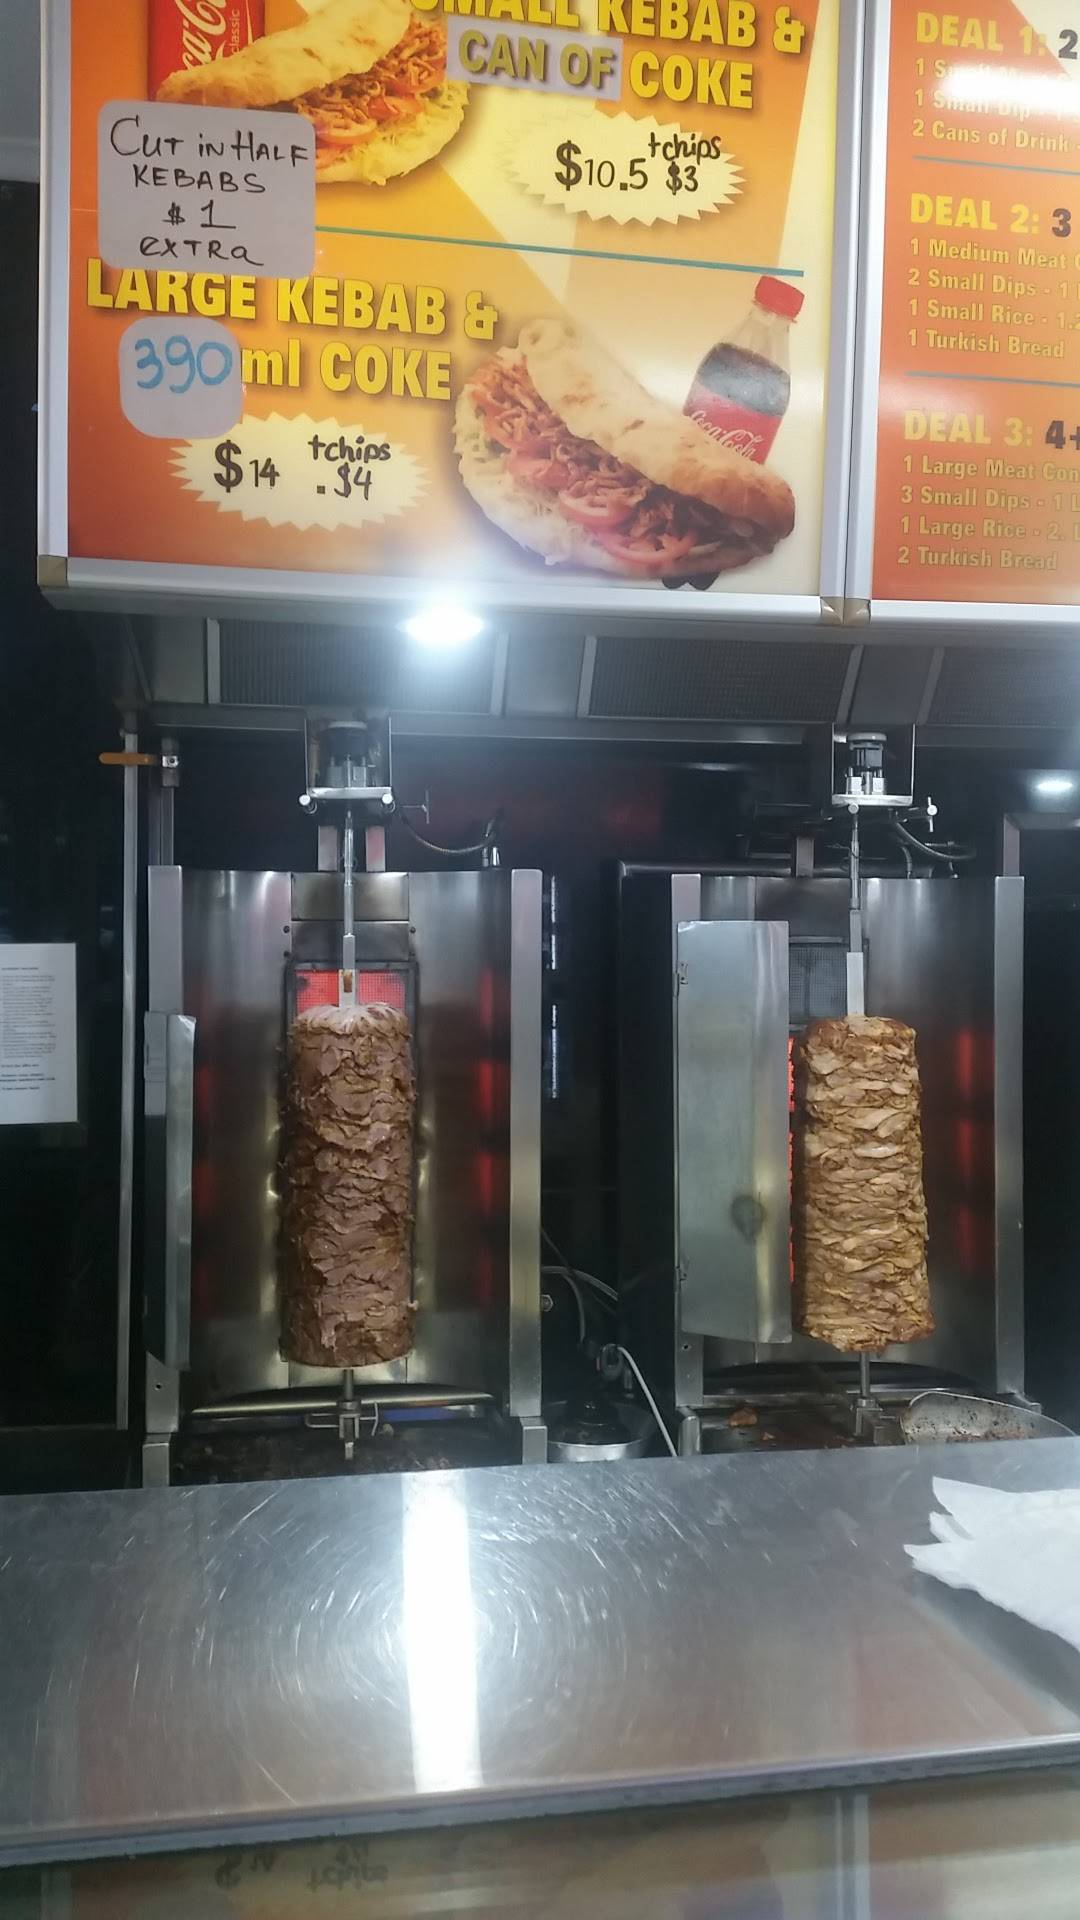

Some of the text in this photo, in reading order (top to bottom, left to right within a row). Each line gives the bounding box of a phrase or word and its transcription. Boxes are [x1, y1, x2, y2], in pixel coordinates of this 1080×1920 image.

[598, 0, 757, 49] KEBAB
[773, 5, 807, 55] &
[916, 11, 1079, 60] DEAL 1: 2
[457, 28, 754, 110] CAN OF COKE
[914, 88, 924, 107] 1
[231, 129, 310, 165] HALF
[912, 119, 1069, 153] 2 Cans of Drink
[132, 163, 266, 194] KEBABS
[666, 161, 700, 196] $3
[910, 192, 1072, 238] DEAL 2: 3
[910, 238, 919, 256] 1
[928, 239, 1009, 265] Medium
[1017, 248, 1067, 270] Meat
[87, 257, 499, 341] LARGE KEBAB &
[908, 268, 920, 286] 2
[928, 269, 984, 291] Small
[992, 275, 1036, 299] Dips
[909, 299, 918, 316] 1
[927, 299, 984, 321] Small
[991, 304, 1035, 325] Rice
[908, 329, 1065, 359] 1 Turkish Bread
[134, 334, 233, 395] 390
[241, 339, 452, 402] ml COKE
[904, 409, 991, 445] DEAL
[1004, 416, 1032, 448] 3:
[903, 454, 912, 473] 1
[922, 455, 978, 479] Large
[985, 459, 1035, 480] Meat
[901, 485, 912, 504] 3
[921, 486, 977, 506] Small
[985, 489, 1030, 512] Dips
[1054, 494, 1062, 511] 1
[900, 515, 910, 533] 1
[919, 517, 975, 540] Large
[983, 519, 1027, 538] Rice
[898, 546, 1058, 571] 2 Turkish Bread
